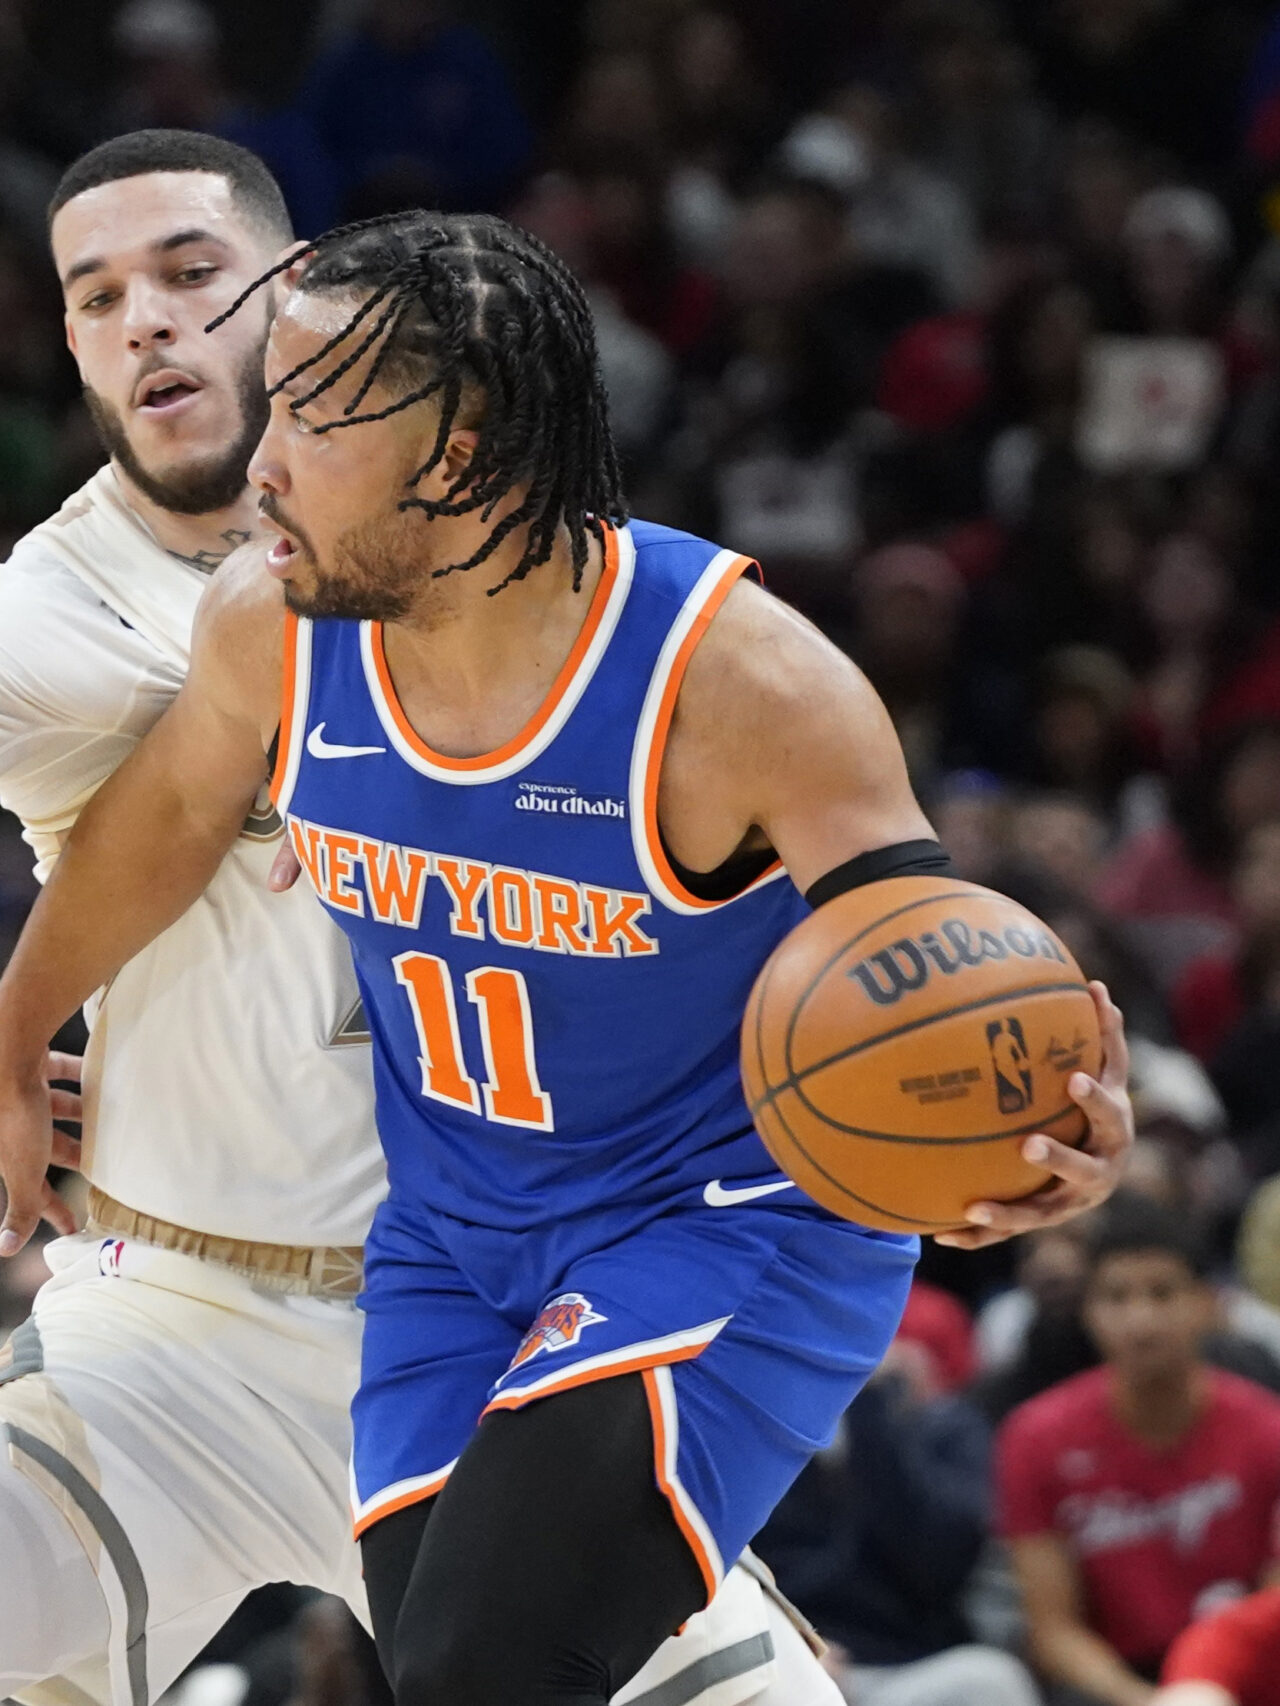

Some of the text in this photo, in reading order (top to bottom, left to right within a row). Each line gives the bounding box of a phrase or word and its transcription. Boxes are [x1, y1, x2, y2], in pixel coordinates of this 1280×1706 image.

[515, 793, 625, 818] abu dhabi
[518, 783, 577, 795] experience
[287, 812, 660, 958] NEW YORK
[845, 918, 1068, 1006] Wilson
[391, 949, 555, 1133] 11
